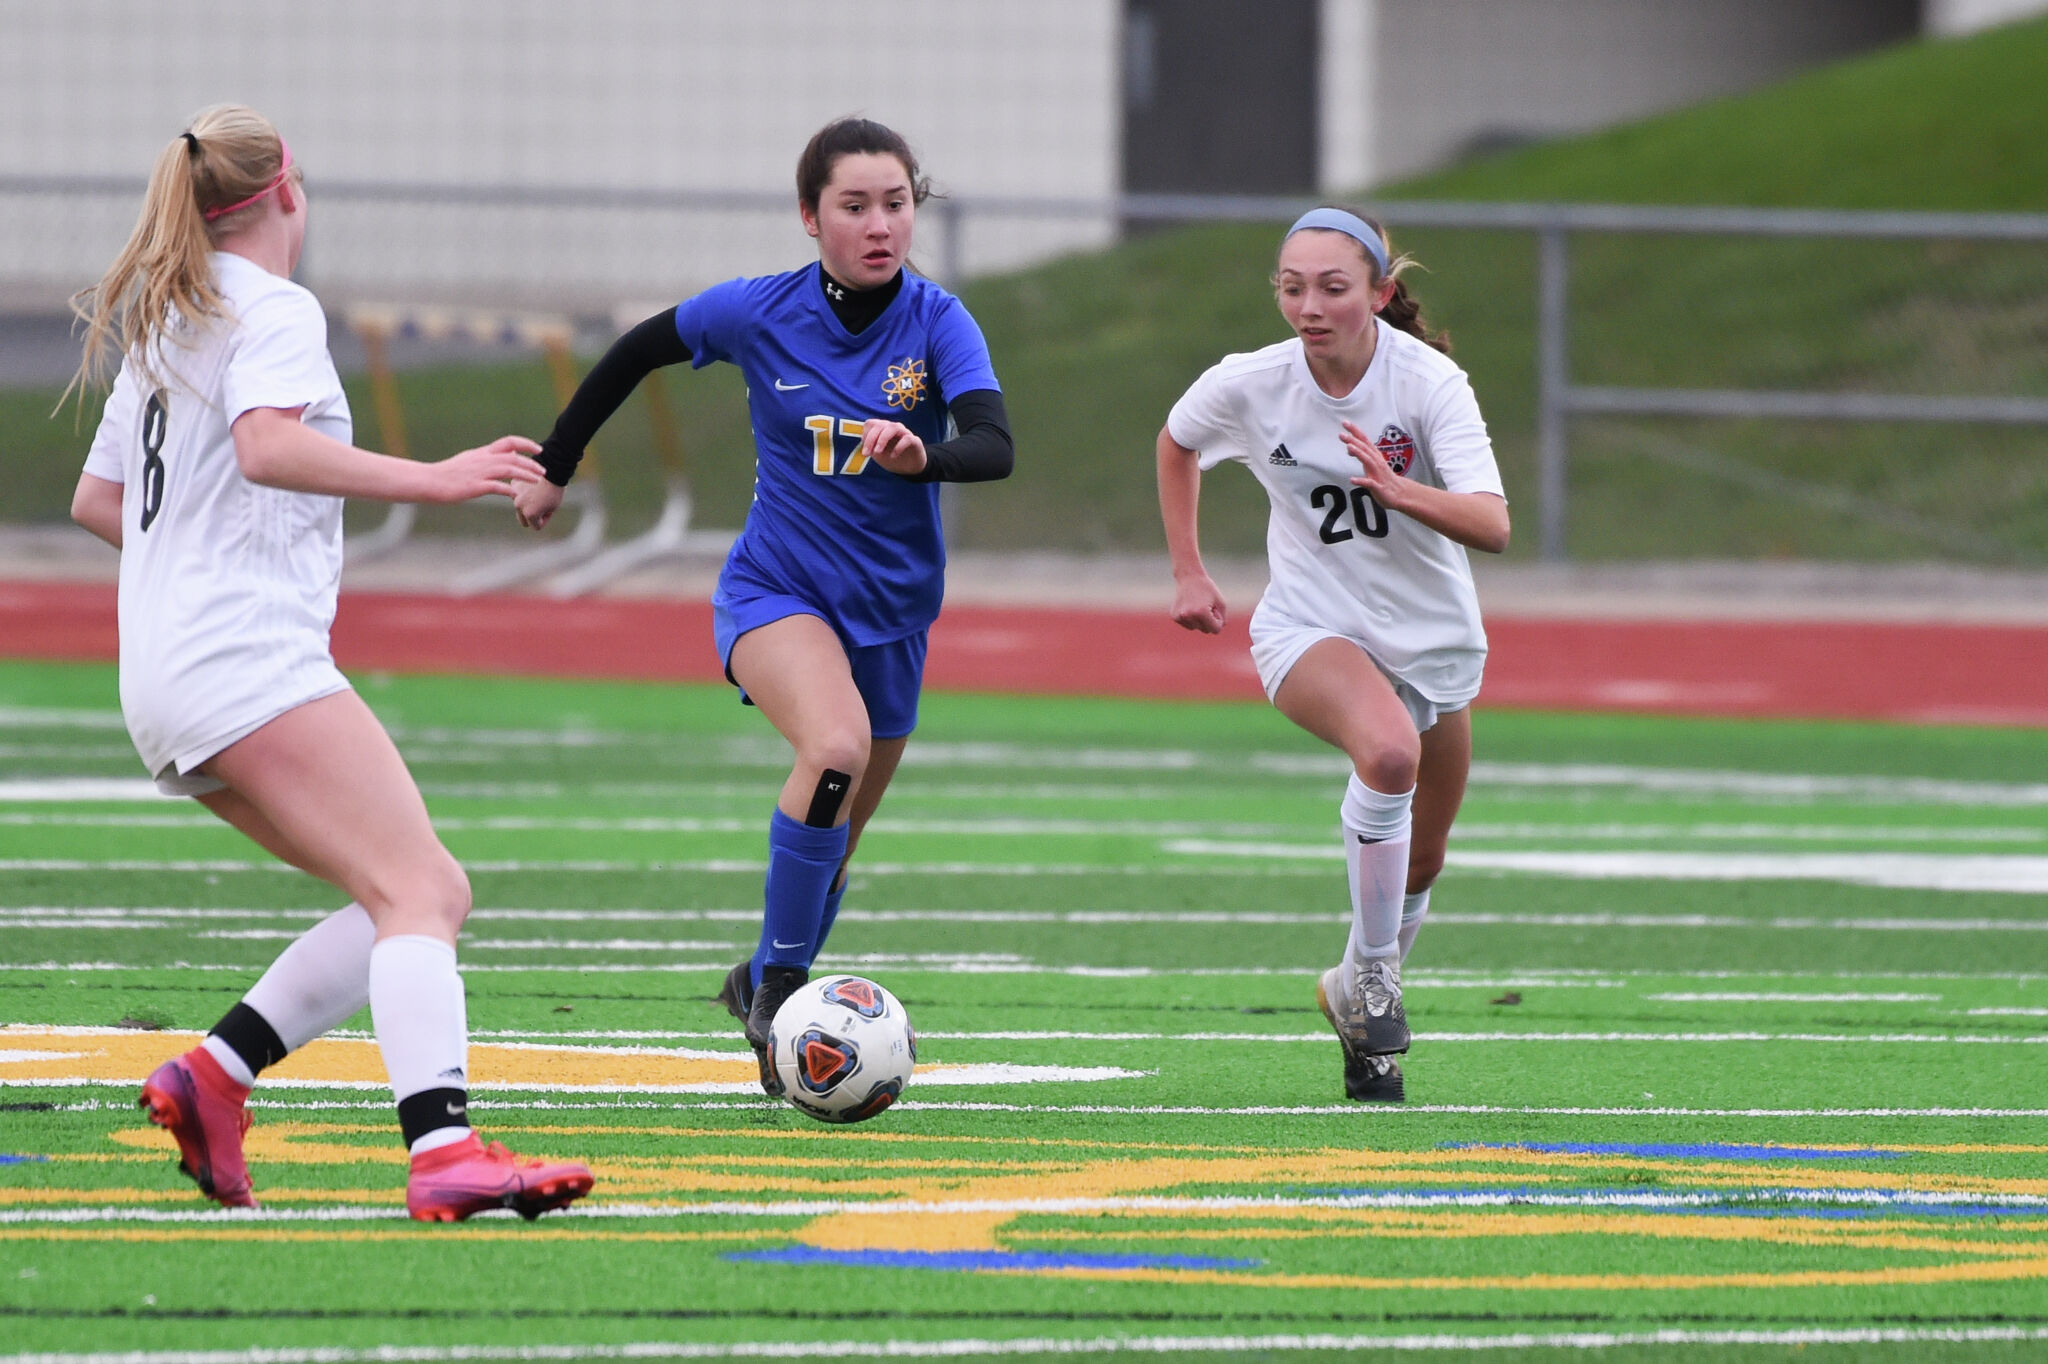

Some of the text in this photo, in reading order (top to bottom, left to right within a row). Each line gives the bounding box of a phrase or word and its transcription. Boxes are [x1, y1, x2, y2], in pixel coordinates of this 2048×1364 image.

[901, 377, 913, 390] M
[141, 388, 168, 533] 8
[804, 414, 871, 476] 17
[1268, 457, 1298, 467] adidas
[1310, 484, 1389, 545] 20
[827, 782, 841, 792] KT
